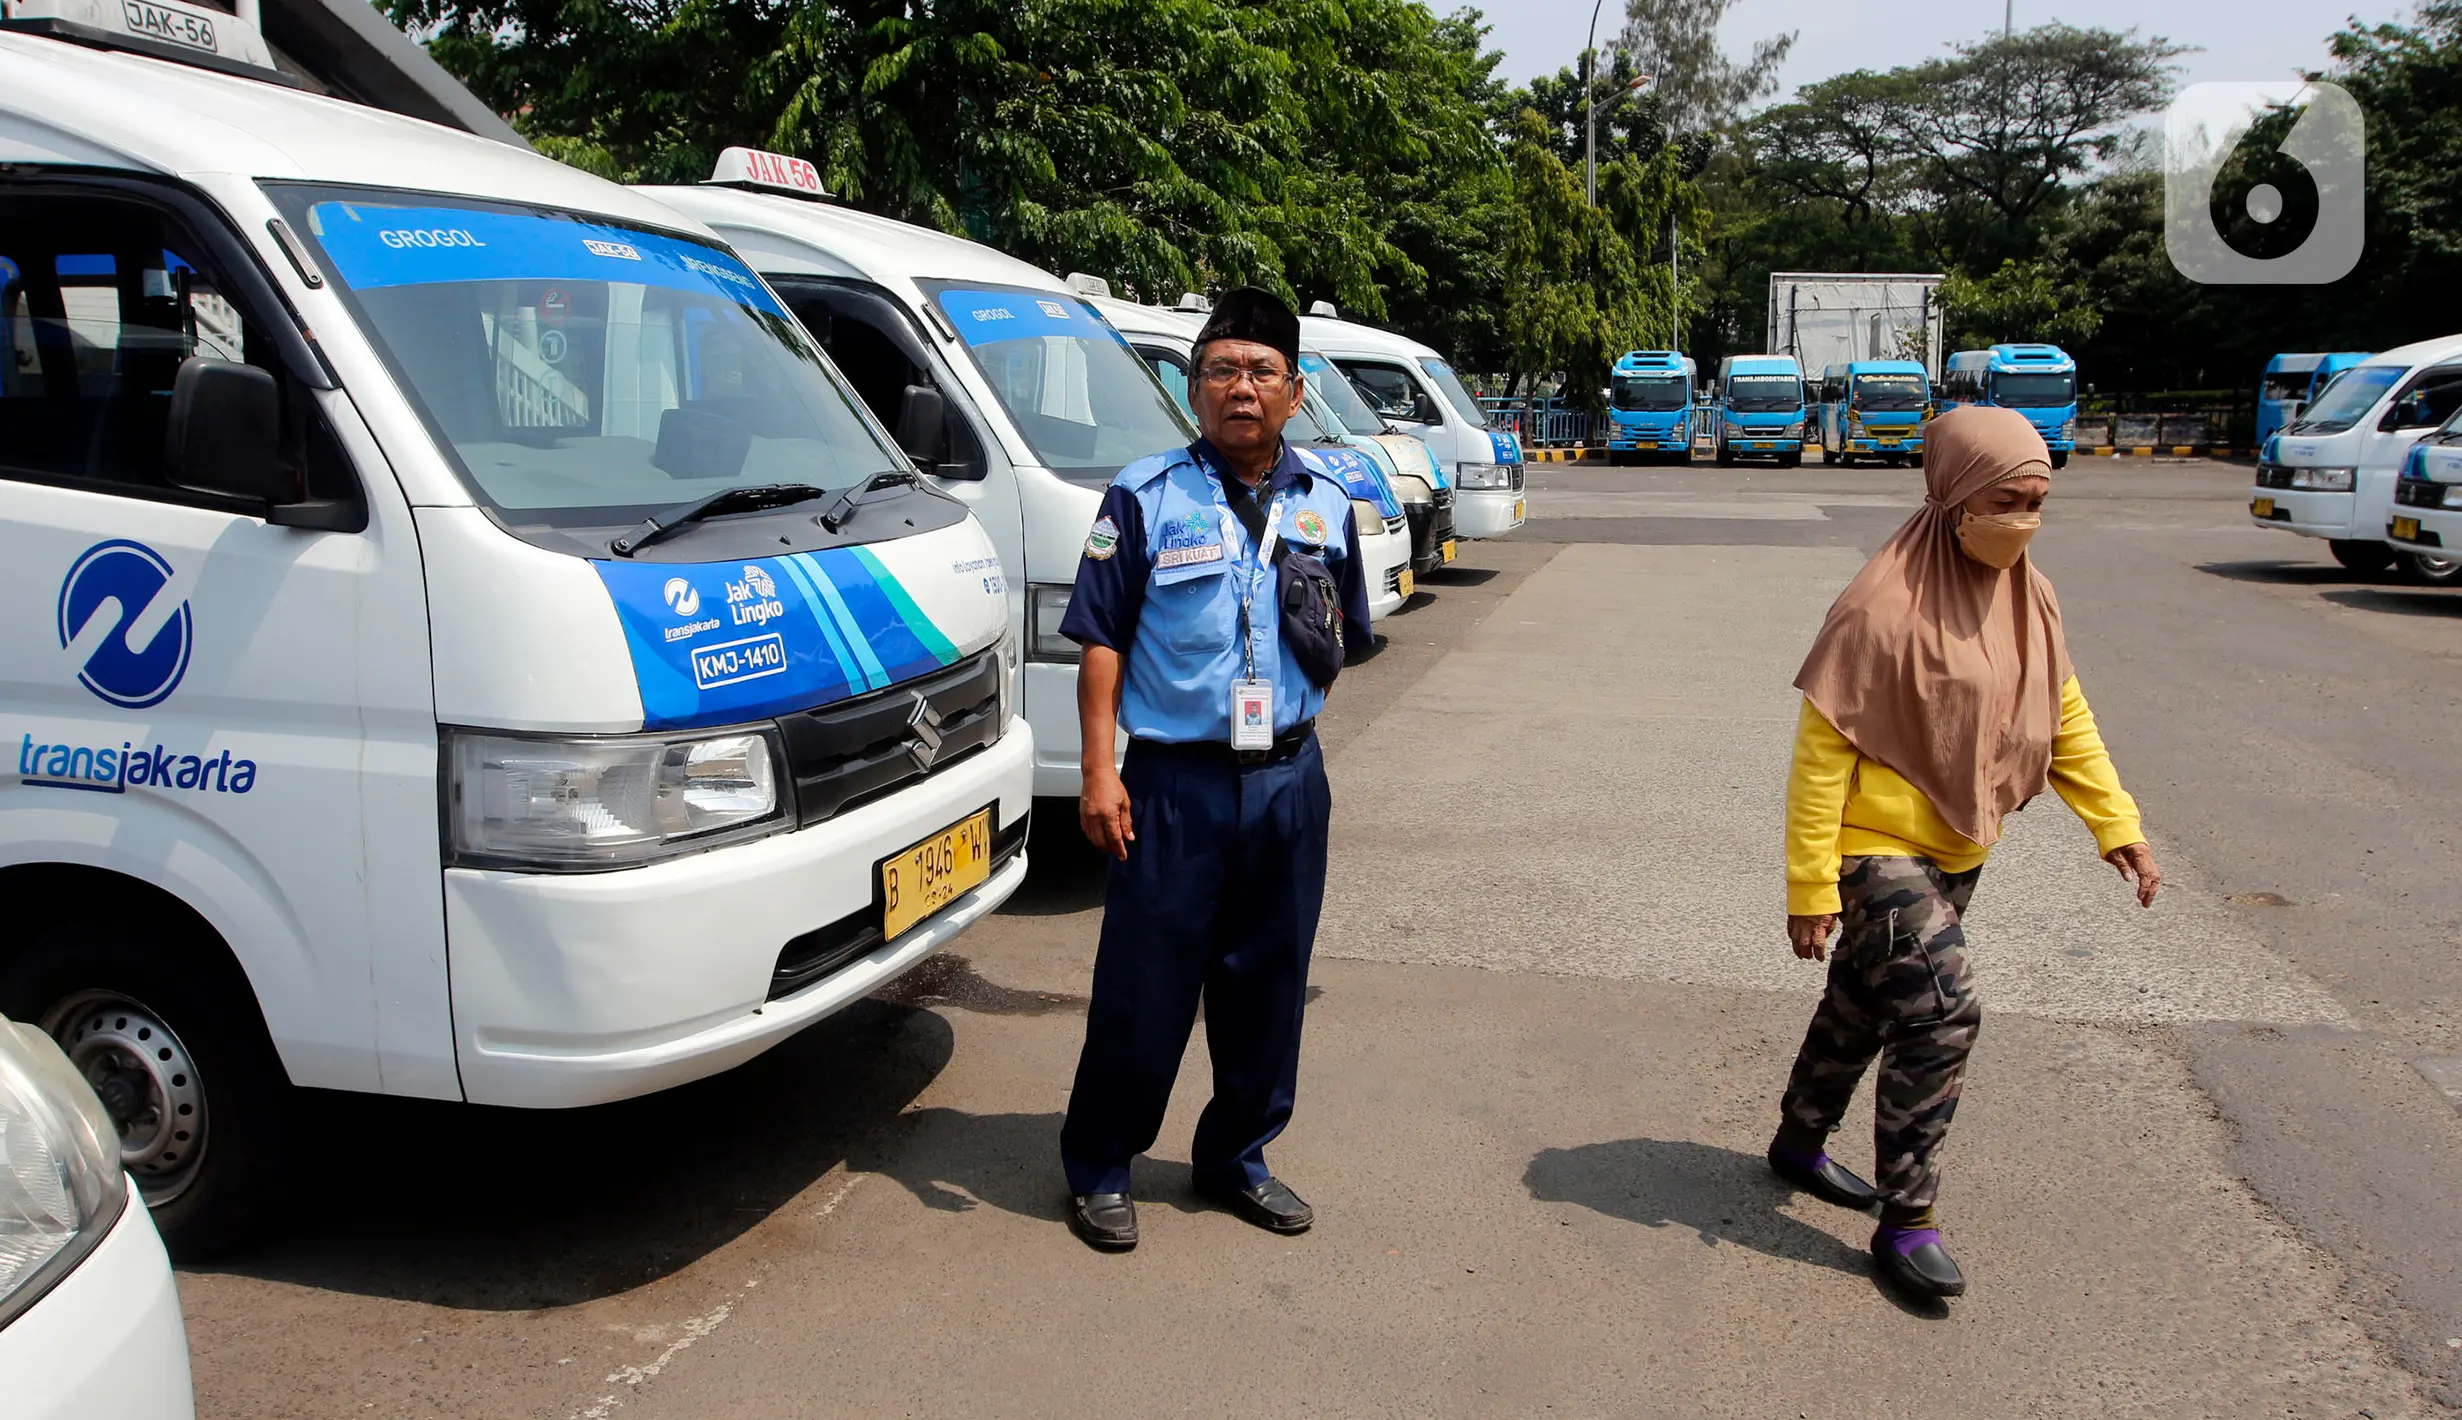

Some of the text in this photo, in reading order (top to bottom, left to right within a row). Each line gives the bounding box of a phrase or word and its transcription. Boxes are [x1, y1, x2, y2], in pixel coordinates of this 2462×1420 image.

[127, 1, 213, 46] JAK-56
[745, 151, 817, 190] JAK 56
[379, 229, 487, 249] GROGOL
[587, 242, 637, 258] JAK-56
[971, 308, 1017, 322] GROGOL
[1162, 547, 1217, 565] SRI KUAT
[725, 579, 754, 604] Jak
[730, 598, 784, 626] Lingko
[664, 618, 721, 642] transjakarta
[699, 642, 780, 679] KMJ-1410
[18, 733, 257, 794] transjakarta
[888, 867, 900, 912] B
[915, 834, 953, 893] 1946
